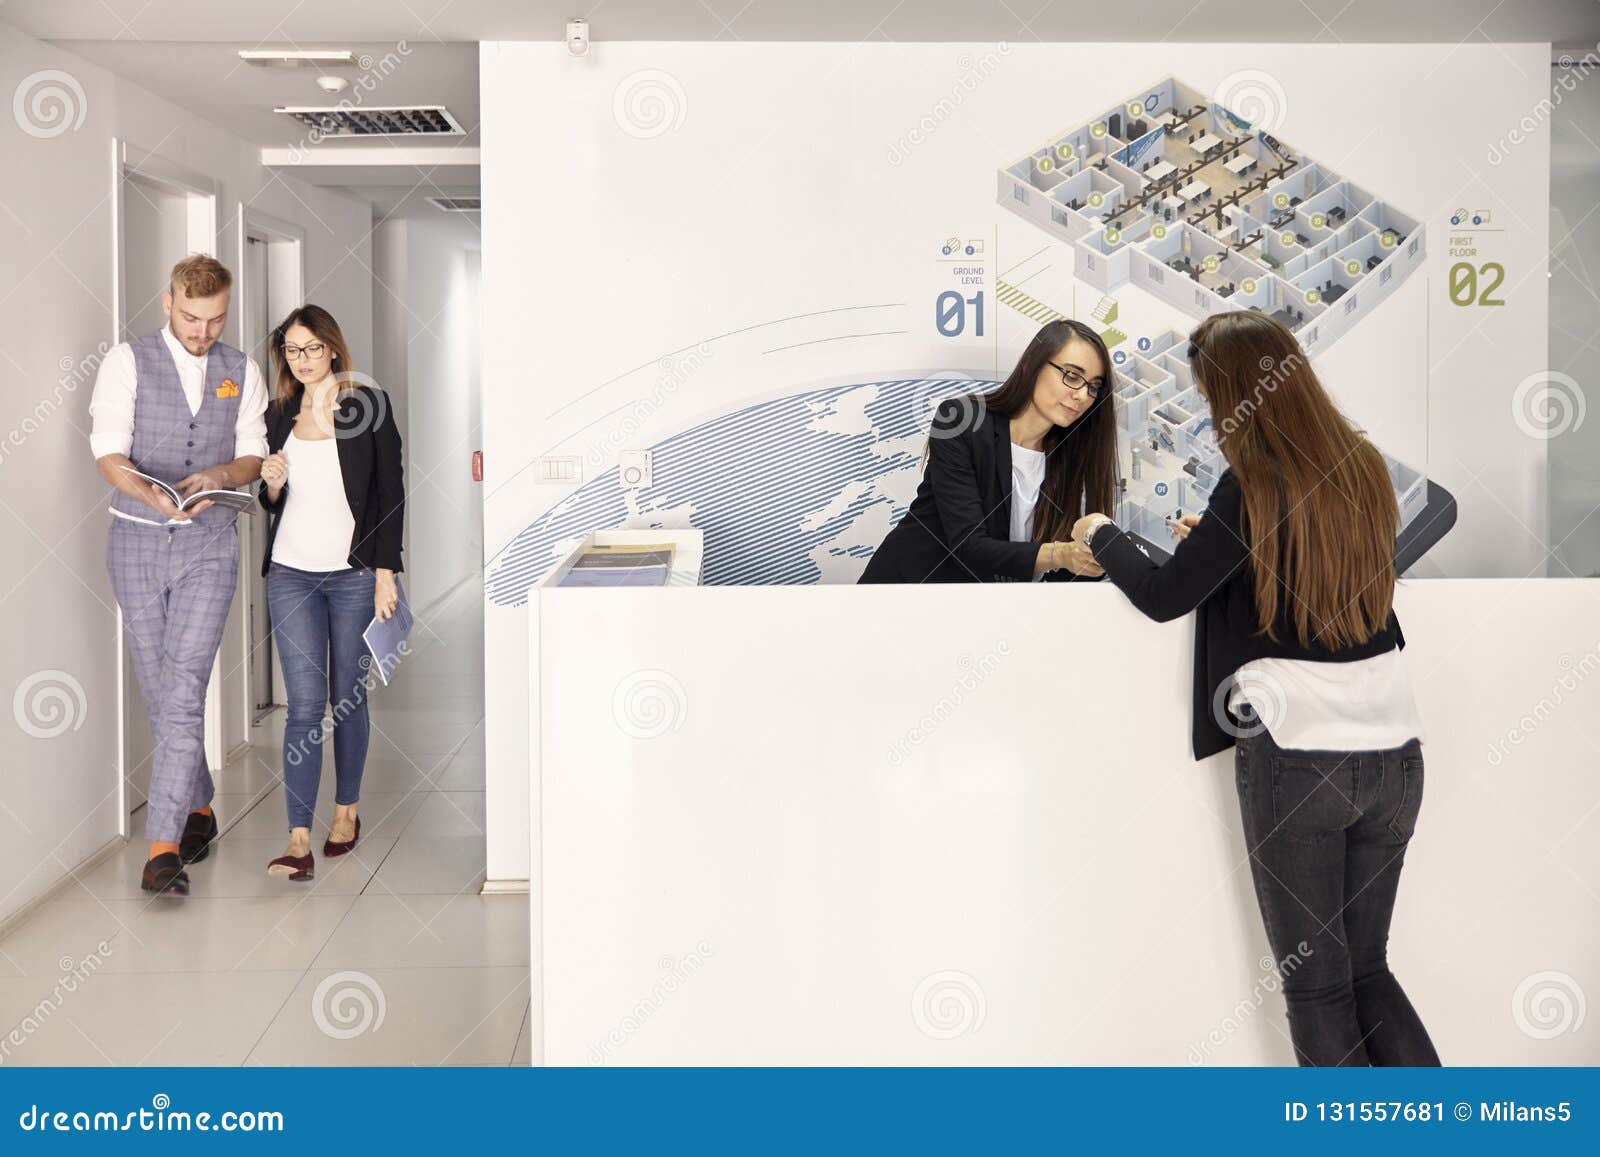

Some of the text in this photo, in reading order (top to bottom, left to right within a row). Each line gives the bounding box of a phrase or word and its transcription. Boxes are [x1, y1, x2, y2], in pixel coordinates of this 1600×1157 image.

[1449, 237, 1473, 246] FIRST
[1449, 248, 1477, 256] FLOOR
[953, 267, 984, 276] GROUND
[961, 276, 984, 285] LEVEL
[1449, 262, 1505, 307] 02
[936, 290, 984, 337] 01
